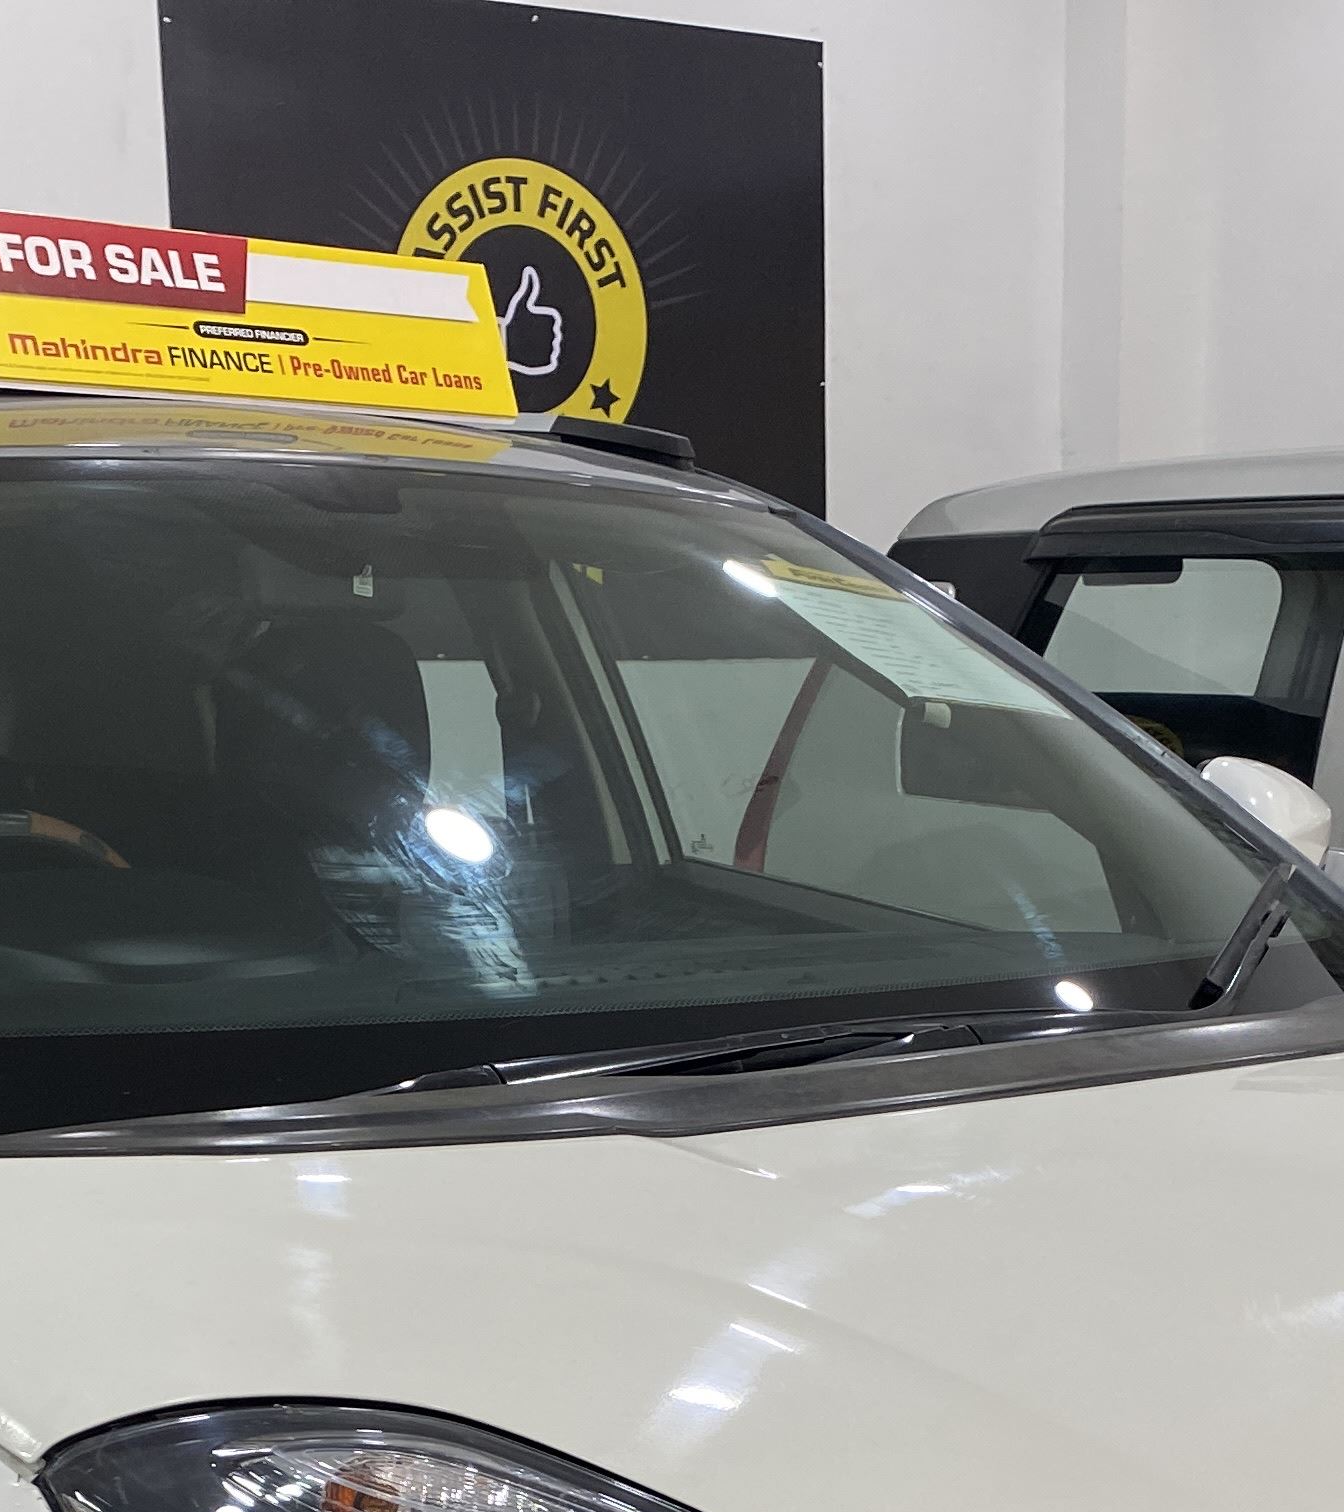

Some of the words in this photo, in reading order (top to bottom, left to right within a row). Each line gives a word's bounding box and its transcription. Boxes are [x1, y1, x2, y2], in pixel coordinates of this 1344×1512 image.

[537, 184, 626, 289] FIRST
[104, 244, 226, 292] SALE
[8, 333, 163, 366] Mahindra
[167, 345, 274, 374] FINANCE
[290, 356, 393, 384] Pre-Owned
[396, 364, 428, 386] Car
[432, 367, 483, 391] Loans
